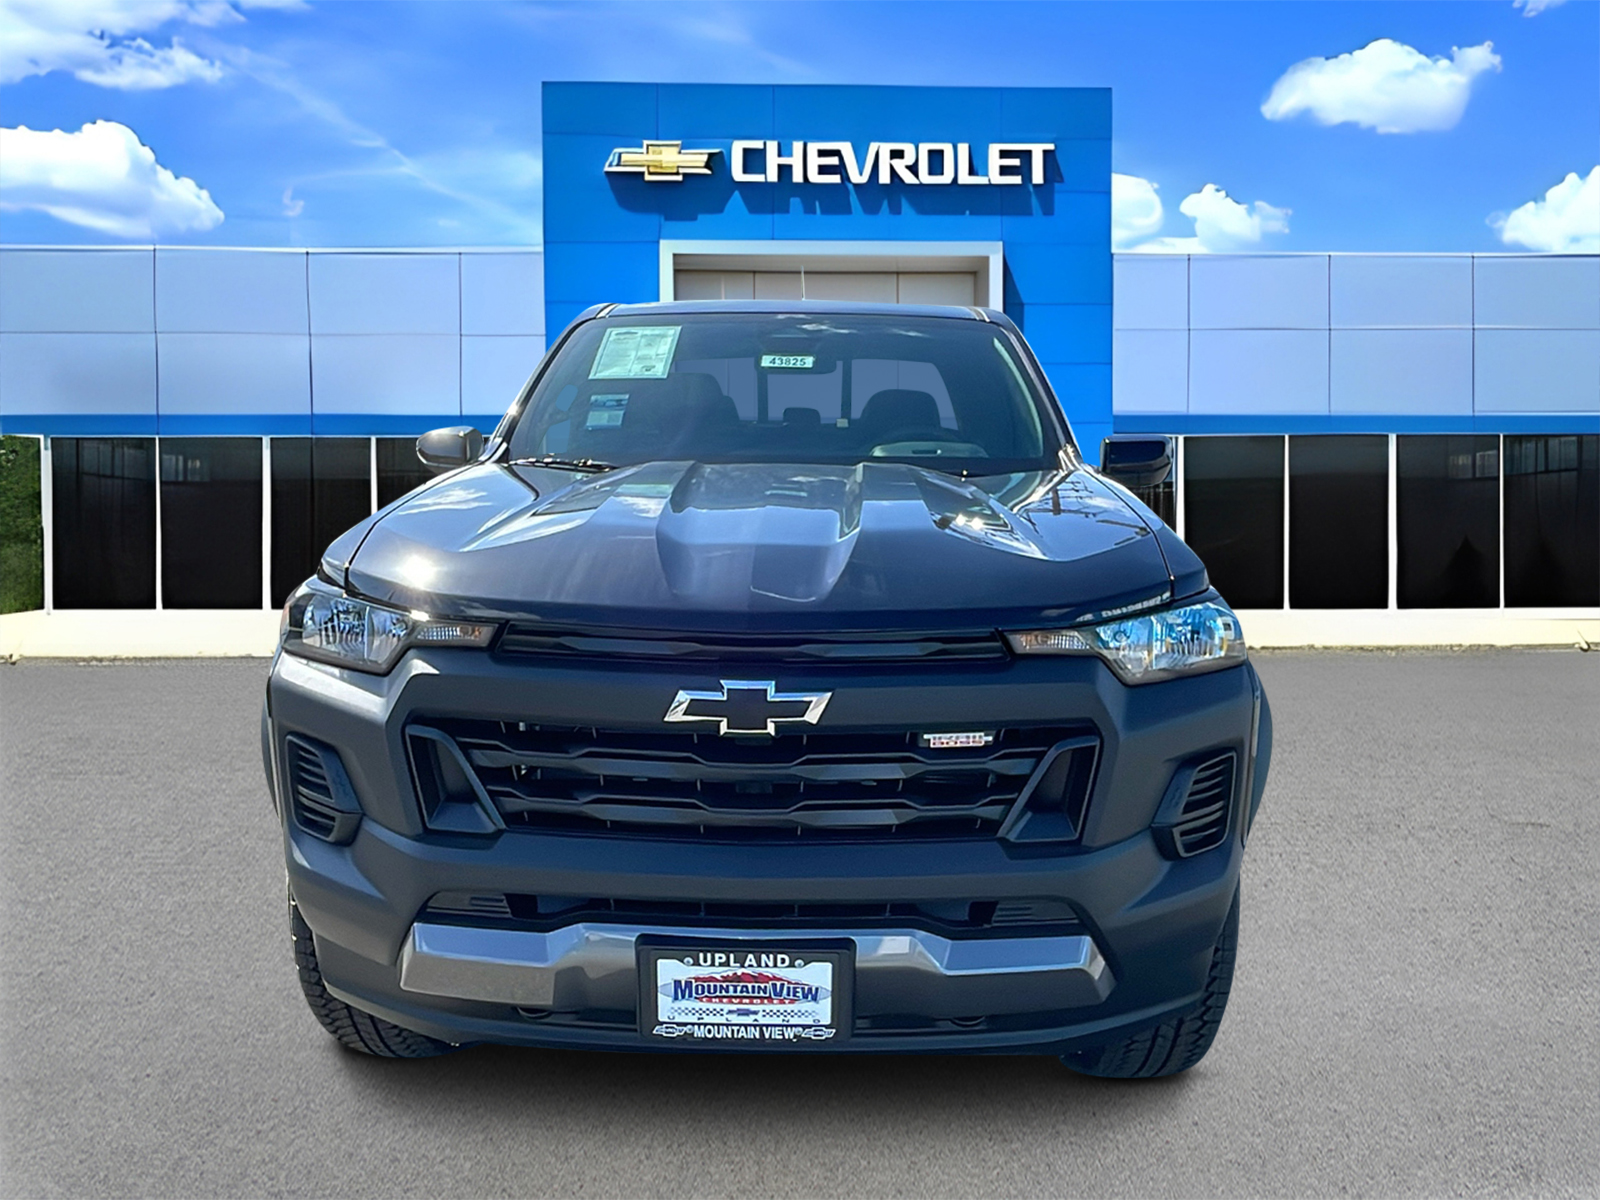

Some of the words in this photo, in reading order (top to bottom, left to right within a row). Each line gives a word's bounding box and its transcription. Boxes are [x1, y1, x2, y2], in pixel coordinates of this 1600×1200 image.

[731, 140, 1055, 184] CHEVROLET
[769, 357, 806, 366] 43825
[699, 953, 790, 967] UPLAND
[694, 1025, 759, 1038] MOUNTAIN
[765, 1027, 795, 1040] VIEW
